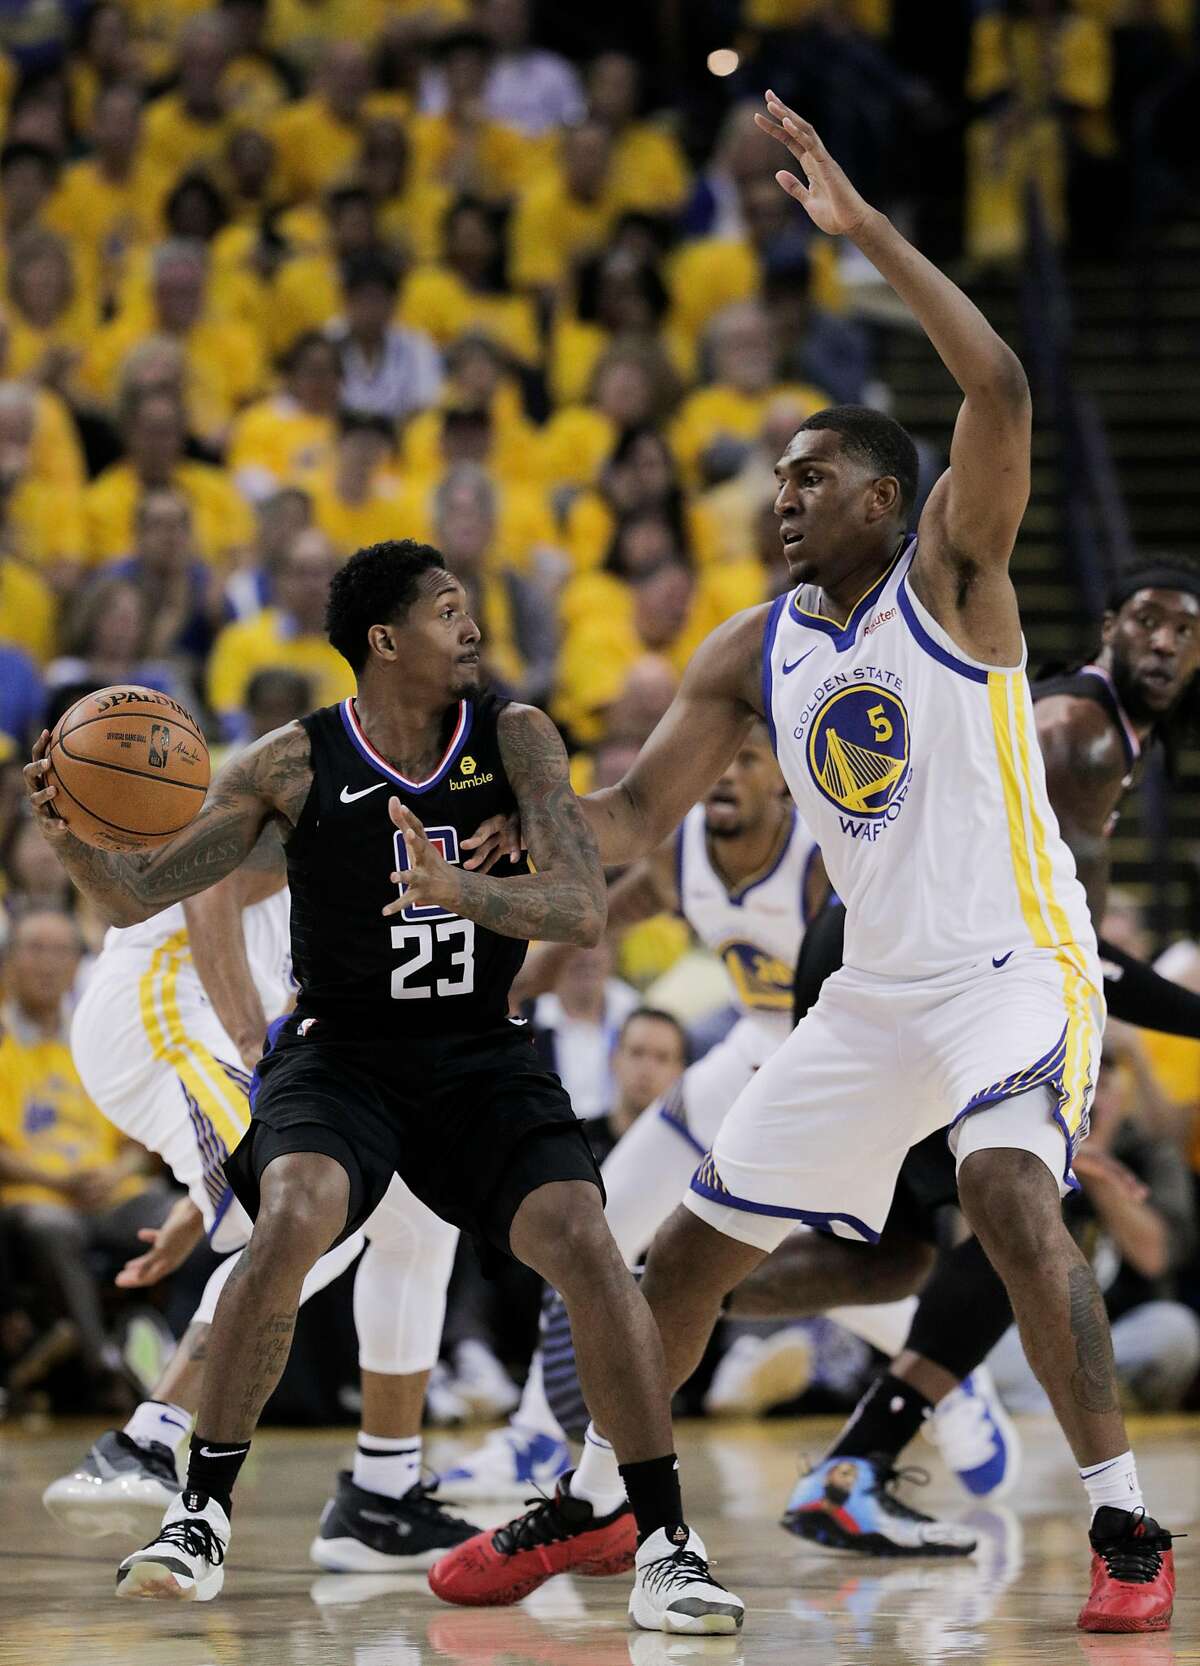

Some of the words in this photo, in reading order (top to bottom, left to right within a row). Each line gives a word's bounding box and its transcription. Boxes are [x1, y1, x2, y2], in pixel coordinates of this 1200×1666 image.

[794, 672, 848, 740] GOLDEN
[853, 666, 903, 691] STATE
[866, 703, 893, 743] 5
[450, 771, 494, 791] bumble
[391, 918, 475, 1000] 23
